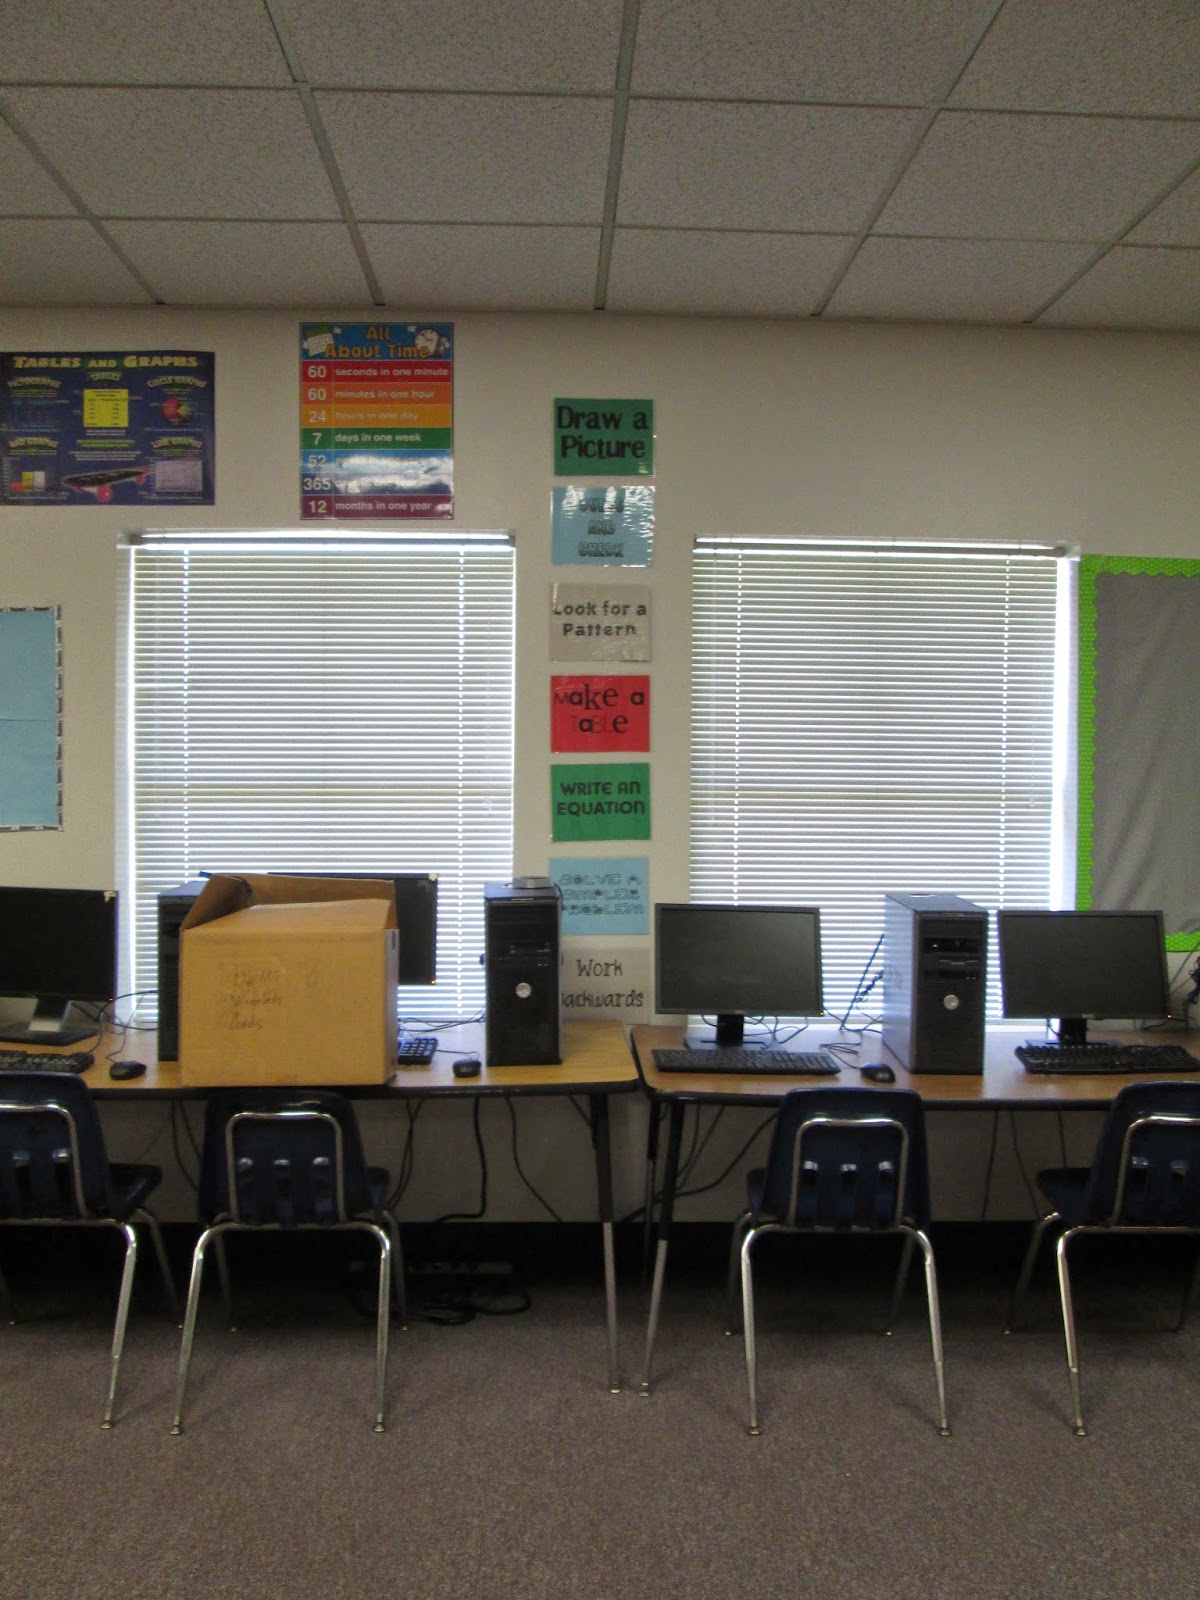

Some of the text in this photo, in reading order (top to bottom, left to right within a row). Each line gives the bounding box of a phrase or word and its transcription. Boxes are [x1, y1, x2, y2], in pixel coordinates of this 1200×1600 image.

[367, 326, 390, 340] All
[324, 343, 430, 358] About Time
[13, 355, 198, 368] TABLES AND GRAPHS
[307, 365, 327, 378] 60
[335, 368, 377, 376] seconds
[380, 368, 390, 376] in
[414, 368, 448, 376] minute
[308, 388, 327, 400] 60
[335, 391, 375, 399] minutes
[308, 410, 327, 423] 24
[335, 412, 364, 420] hours
[367, 412, 376, 420] in
[400, 412, 419, 421] day
[557, 405, 648, 430] Draw a
[312, 432, 322, 445] 7
[334, 433, 359, 442] days
[361, 433, 372, 442] in
[395, 433, 422, 442] week
[561, 435, 646, 459] Picture
[308, 455, 326, 468] 52
[303, 478, 331, 490] 365
[308, 500, 327, 513] 12
[335, 501, 373, 510] months
[376, 501, 386, 510] in
[410, 503, 432, 512] year
[602, 600, 631, 616] for
[636, 605, 647, 616] a
[562, 623, 637, 637] Pattern
[553, 683, 645, 710] Make a
[560, 781, 613, 796] WRITE
[576, 959, 623, 977] Work
[561, 988, 644, 1008] ackwards
